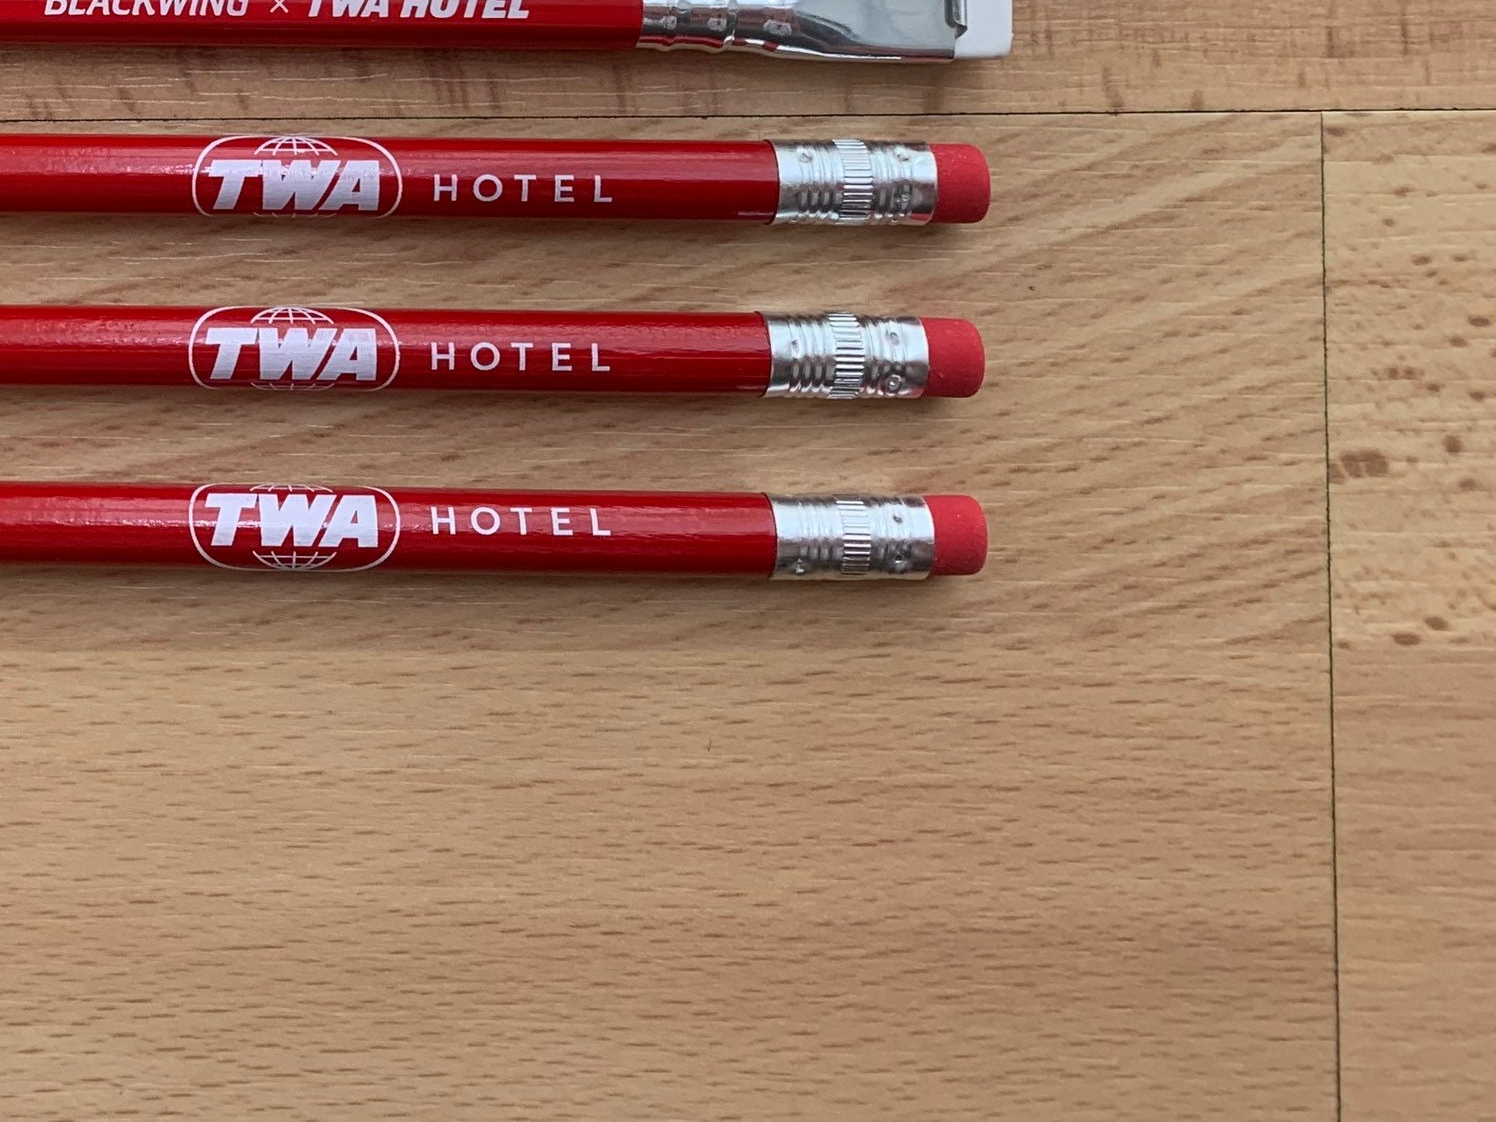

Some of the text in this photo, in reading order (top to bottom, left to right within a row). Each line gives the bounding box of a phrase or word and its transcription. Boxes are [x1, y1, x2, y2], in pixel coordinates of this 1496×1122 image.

[206, 158, 614, 212] TWA HOTEL
[204, 326, 612, 382] TWA HOTEL
[204, 491, 613, 548] TWA HOTEL
